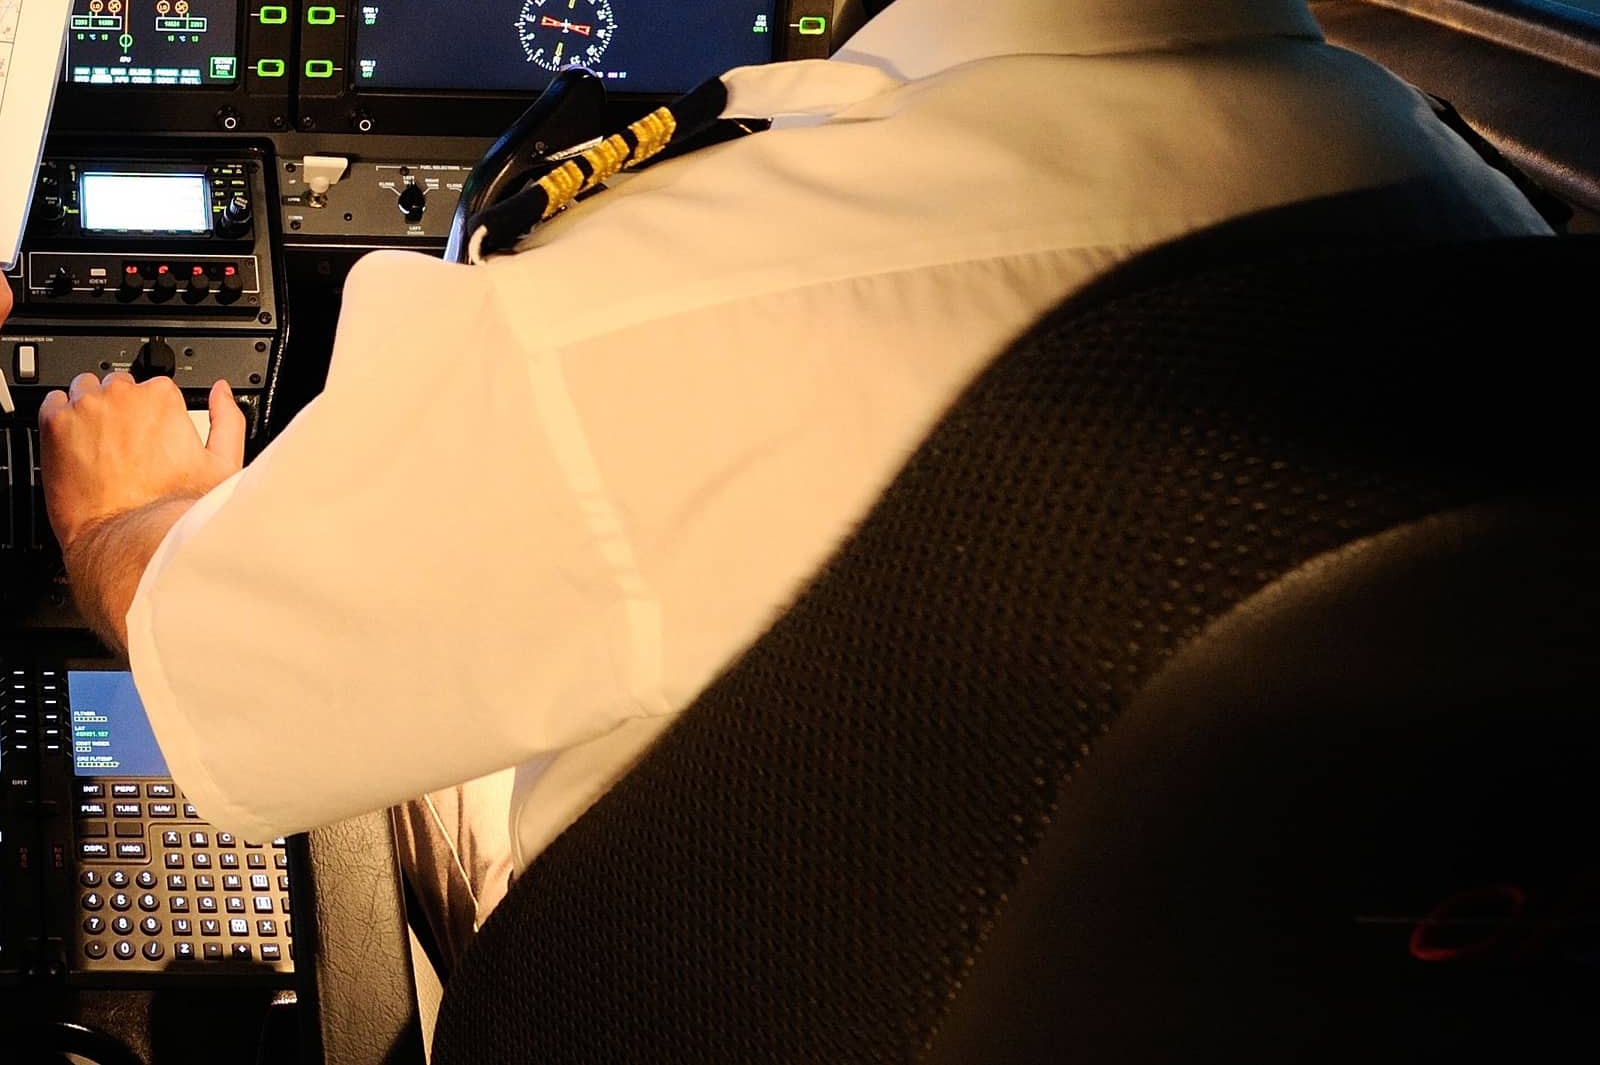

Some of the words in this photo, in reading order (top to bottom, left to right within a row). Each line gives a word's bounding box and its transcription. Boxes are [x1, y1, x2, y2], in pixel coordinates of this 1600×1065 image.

[526, 13, 535, 23] E
[116, 805, 138, 813] TUNE
[115, 872, 123, 881] 2
[143, 870, 150, 881] 3
[173, 876, 182, 884] K
[228, 876, 237, 884] M
[88, 894, 96, 904] 4
[203, 898, 212, 907] Q
[119, 919, 127, 928] 8
[147, 919, 155, 928] 9
[179, 921, 187, 930] U
[206, 921, 215, 930] V
[263, 921, 272, 930] X
[121, 944, 129, 954] 0
